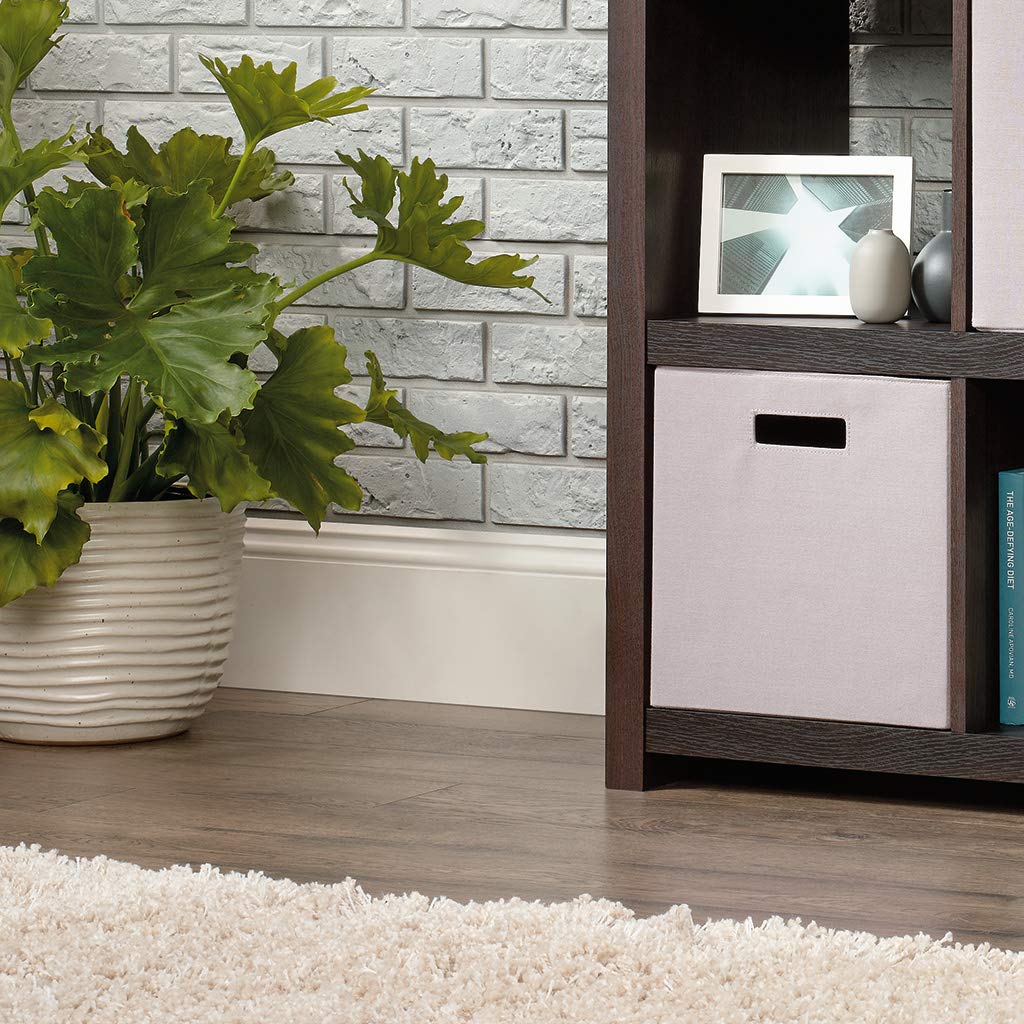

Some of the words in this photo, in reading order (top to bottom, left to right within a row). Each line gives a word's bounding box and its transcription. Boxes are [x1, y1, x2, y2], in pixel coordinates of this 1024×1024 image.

[1006, 491, 1014, 508] THE
[1006, 511, 1015, 568] AGE-DEFYING
[1007, 570, 1015, 590] DIET
